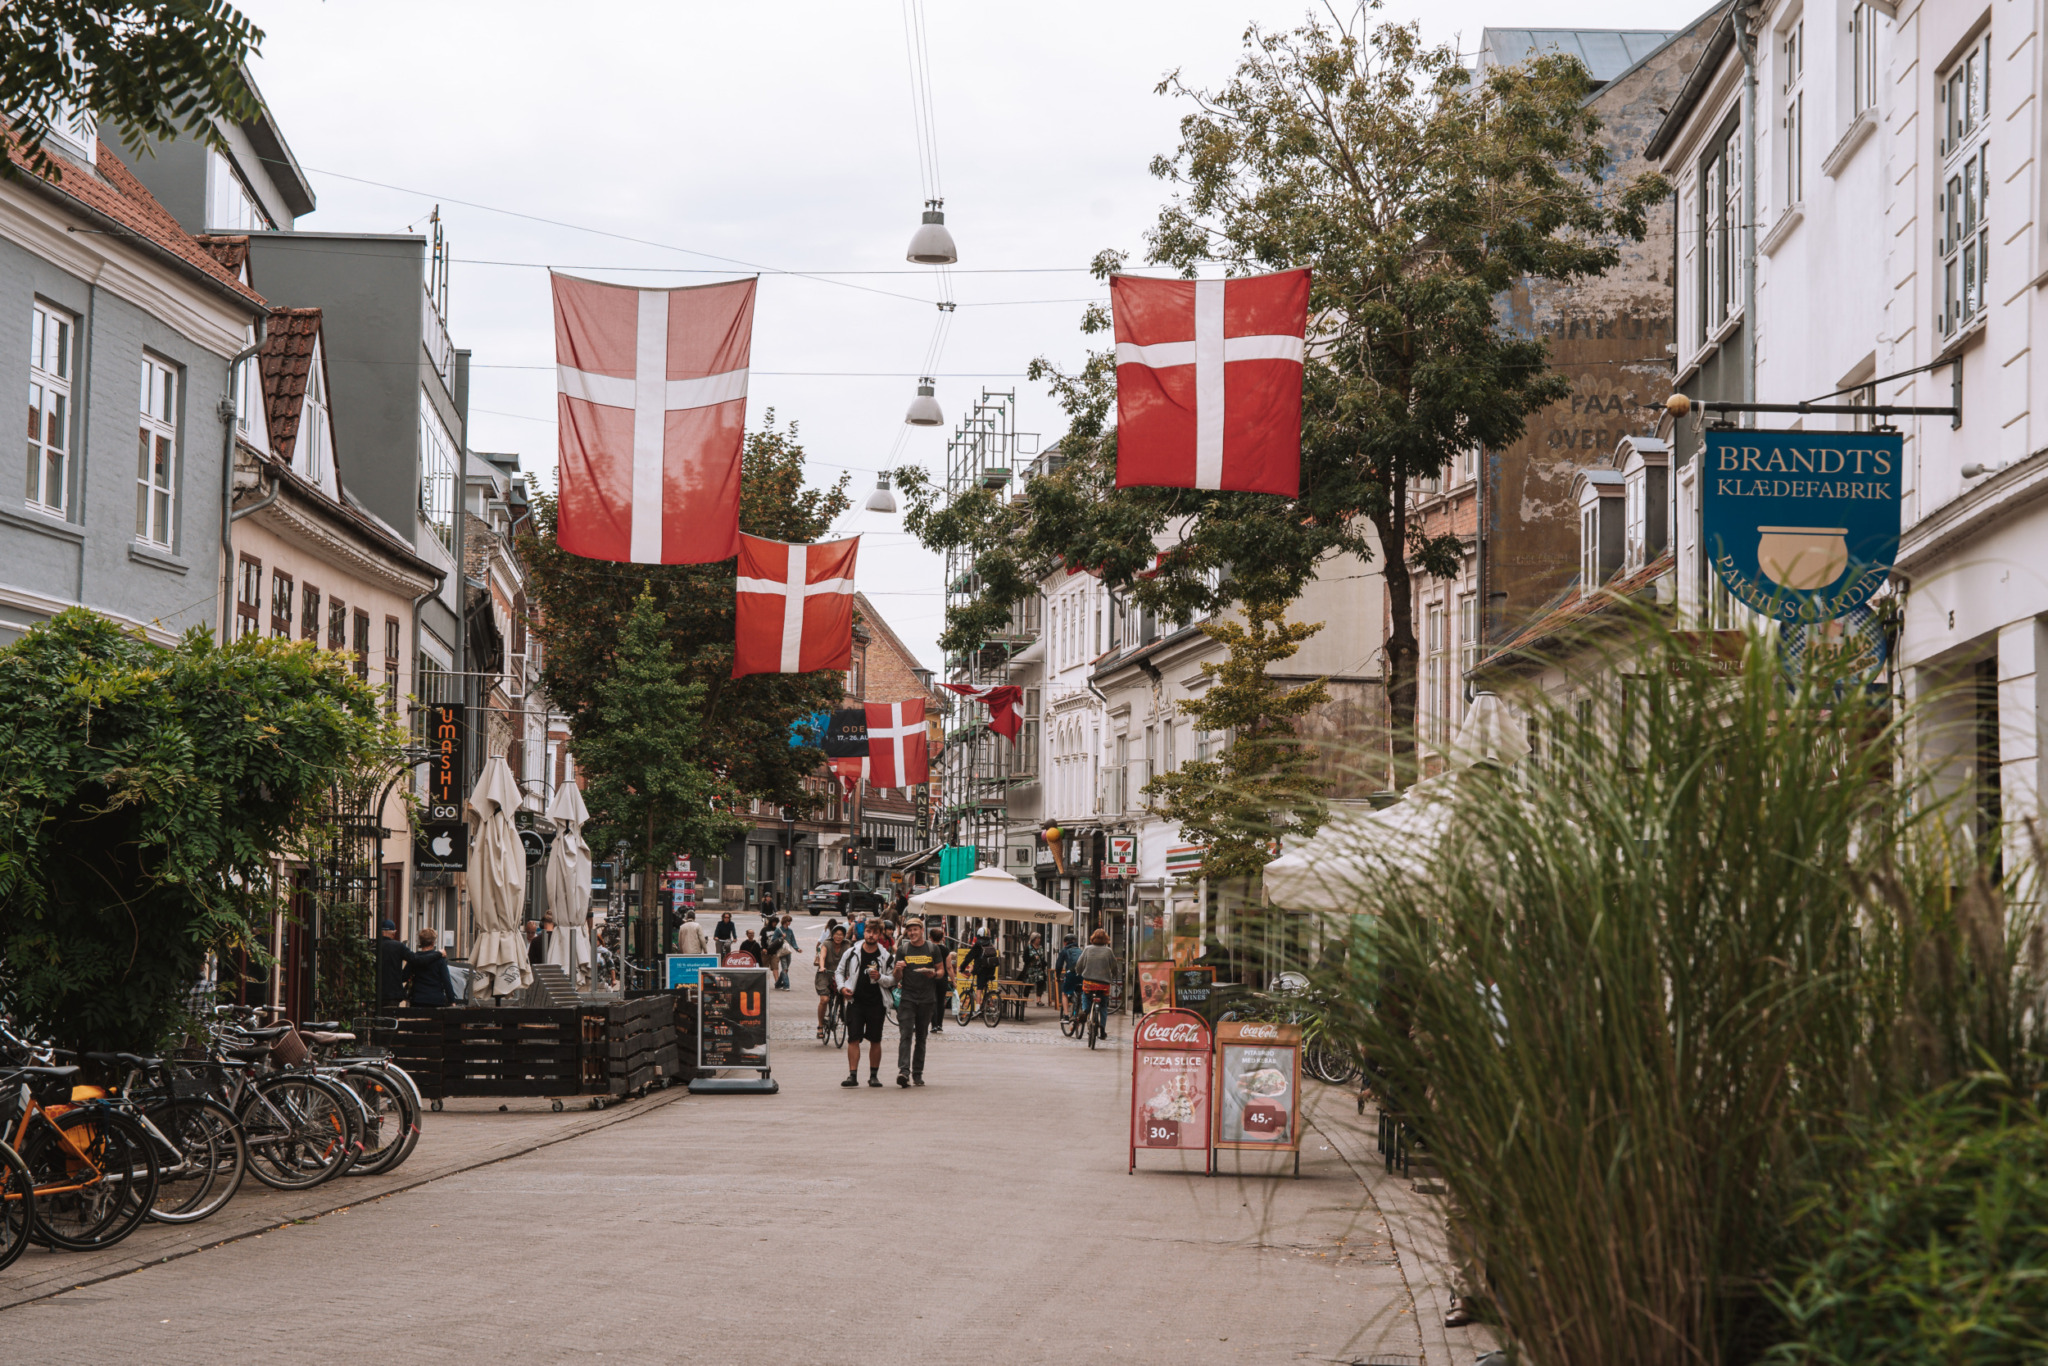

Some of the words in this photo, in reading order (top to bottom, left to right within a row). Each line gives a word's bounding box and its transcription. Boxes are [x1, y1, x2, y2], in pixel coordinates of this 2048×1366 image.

[1717, 446, 1892, 475] BRANDTS
[1716, 478, 1892, 500] KLÆDEFABRIK
[438, 708, 456, 801] UMASHI
[434, 806, 456, 818] GO
[917, 785, 928, 839] ANSEN
[1143, 1056, 1172, 1066] PIZZA
[1174, 1056, 1202, 1066] SLICE
[1250, 1113, 1273, 1126] 45,-
[1150, 1126, 1176, 1140] 30,-
